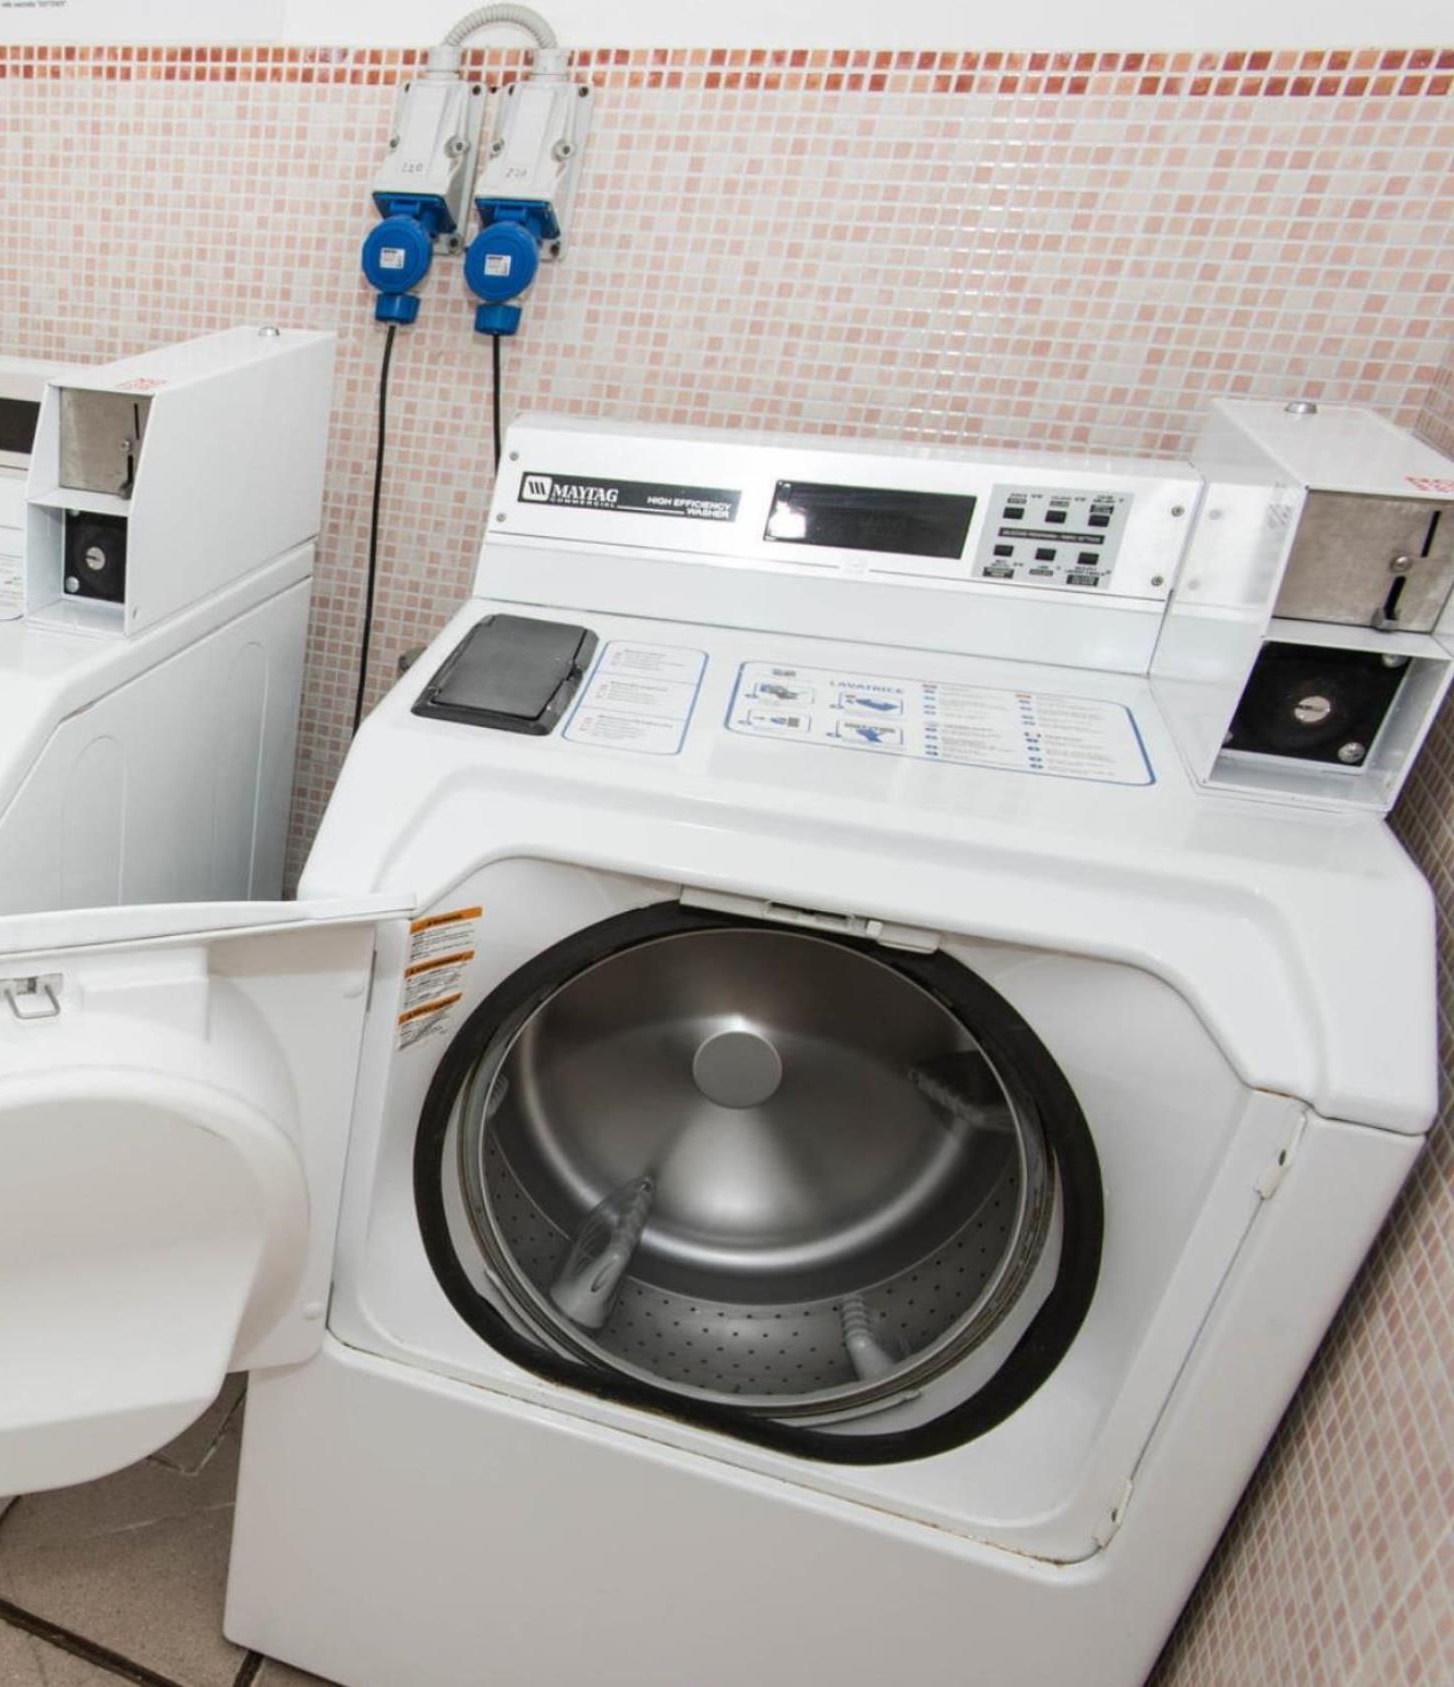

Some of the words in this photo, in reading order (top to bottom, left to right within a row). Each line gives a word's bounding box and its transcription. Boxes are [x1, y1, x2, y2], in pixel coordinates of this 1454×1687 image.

[551, 484, 619, 502] MAYTAG
[646, 496, 672, 505] HIGH
[673, 498, 733, 511] EFFICIENCY
[686, 507, 730, 520] WASHER
[829, 681, 904, 693] LAVATRICE
